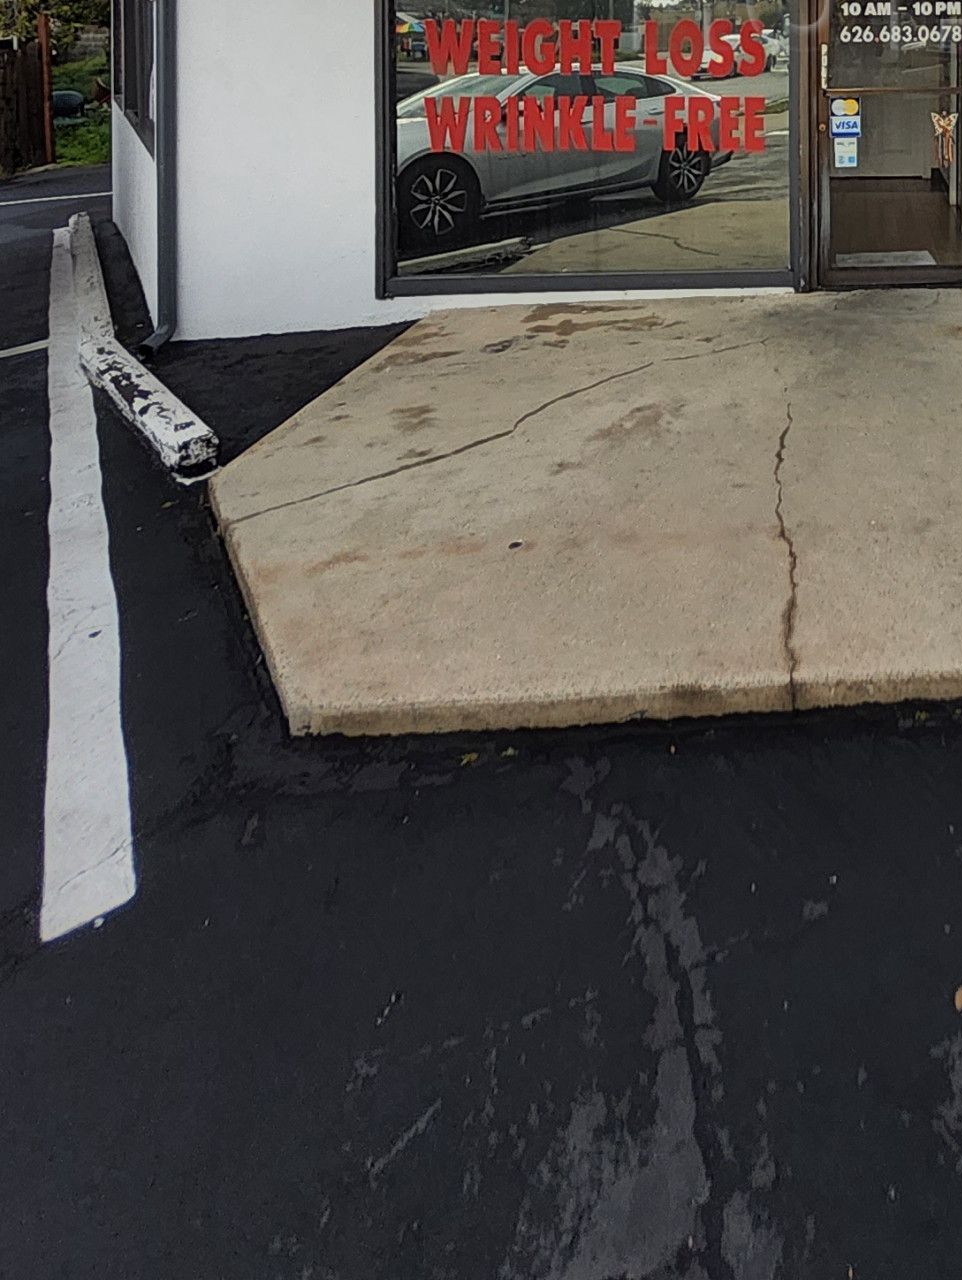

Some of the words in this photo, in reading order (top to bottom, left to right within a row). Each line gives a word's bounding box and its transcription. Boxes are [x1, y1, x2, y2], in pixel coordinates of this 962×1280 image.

[841, 2, 861, 16] 10
[864, 2, 891, 16] AM
[912, 2, 933, 16] 10
[935, 1, 962, 16] PM
[840, 25, 962, 43] 626.683.0678
[423, 18, 622, 76] WEIGHT
[644, 18, 766, 77] LOSS
[423, 95, 766, 153] WRINKLE-FREE
[835, 121, 858, 130] VISA
